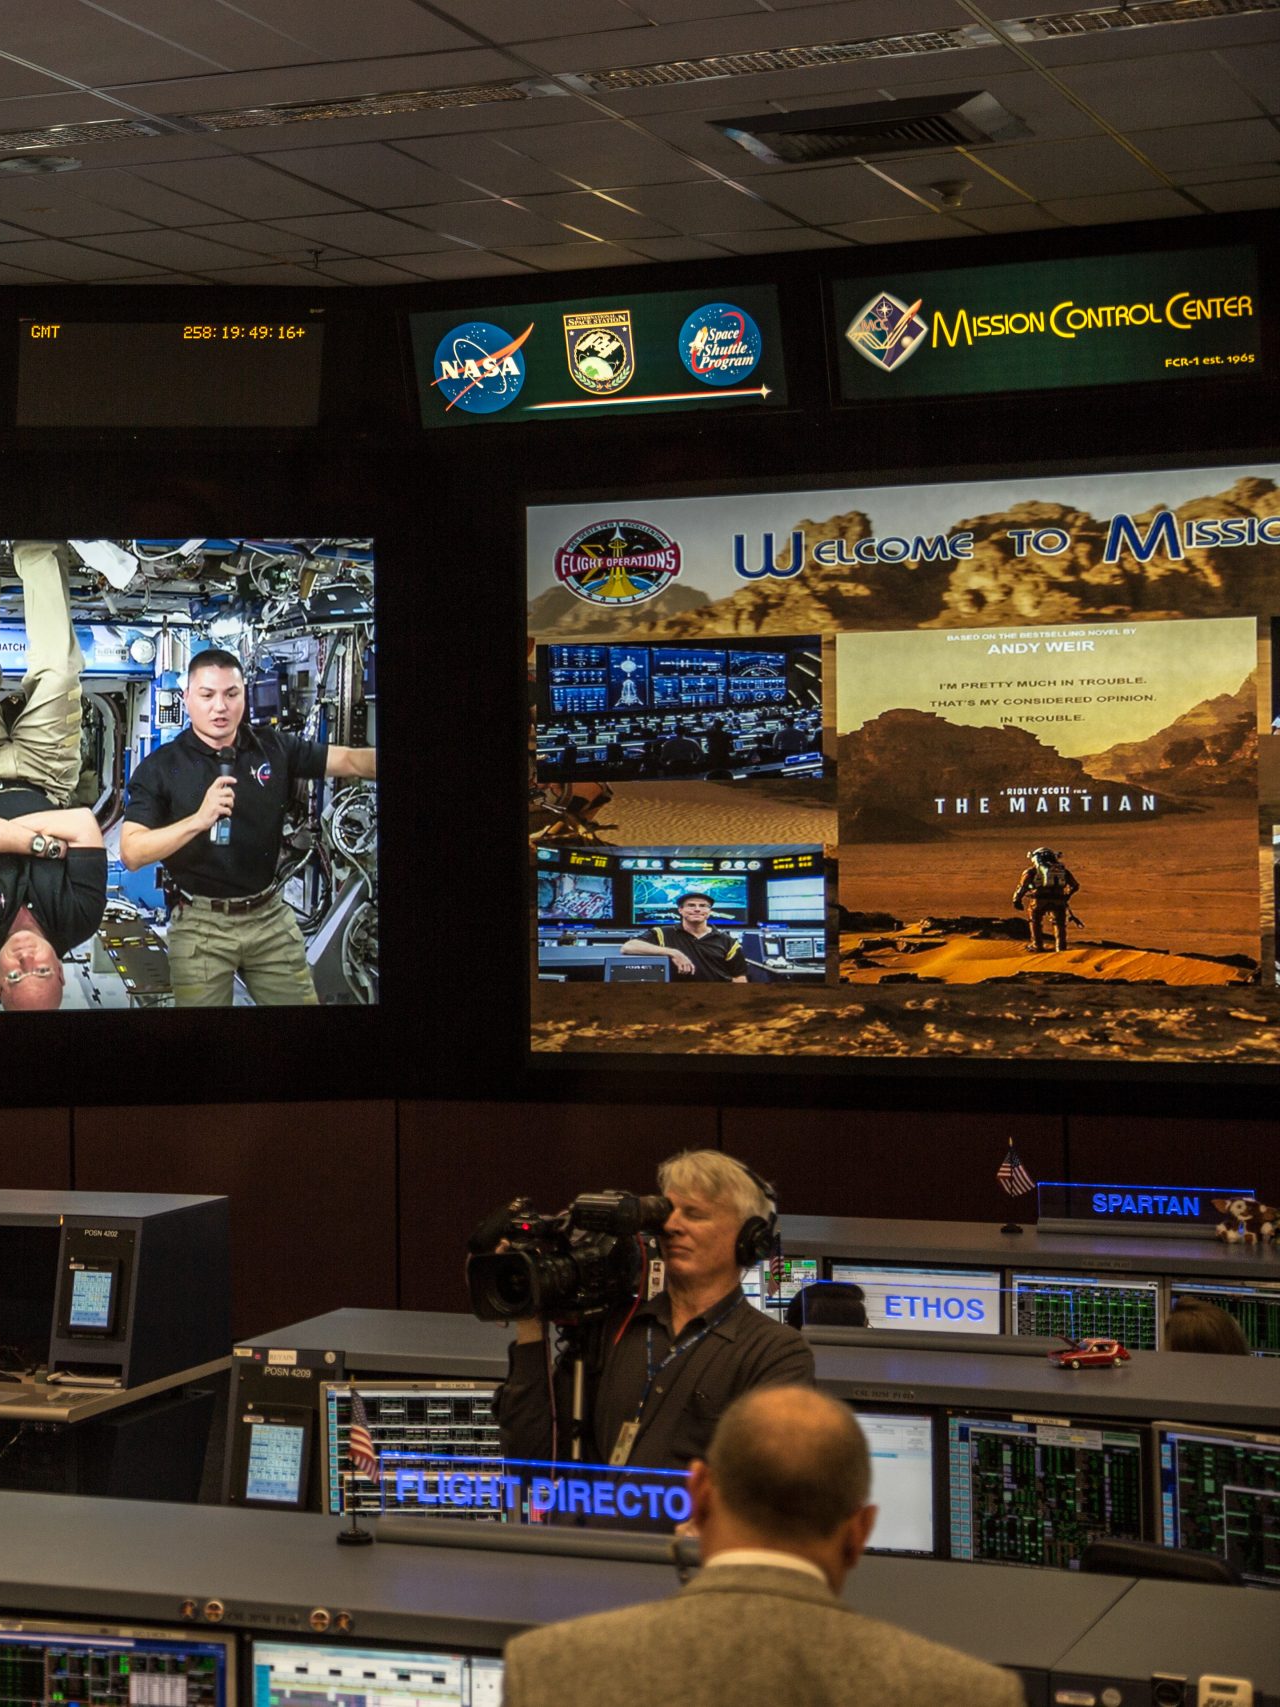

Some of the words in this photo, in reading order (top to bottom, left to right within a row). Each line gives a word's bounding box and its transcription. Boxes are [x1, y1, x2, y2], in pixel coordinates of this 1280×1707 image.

[567, 317, 593, 326] SPACE
[594, 314, 627, 324] STATION
[1049, 301, 1161, 338] CONTROL
[1166, 292, 1253, 329] CENTER
[31, 325, 60, 339] GMT
[708, 327, 740, 342] Space
[703, 341, 748, 356] Shuttle
[440, 356, 521, 380] NASA
[699, 354, 754, 371] Program
[1164, 357, 1199, 368] FCR-1
[1202, 355, 1224, 365] est.
[1226, 353, 1255, 364] 1965
[733, 530, 974, 580] WELCOME
[1007, 528, 1071, 557] TO
[561, 554, 605, 576] FLIGHT
[606, 550, 676, 569] OPERATIONS
[946, 634, 980, 642] BASED
[982, 633, 997, 641] ON
[998, 632, 1017, 640] THE
[1019, 630, 1086, 639] BESTSELLING
[1087, 628, 1122, 638] NOVEL
[1122, 627, 1137, 636] BY
[987, 642, 1041, 656] ANDY
[1045, 640, 1095, 653] WEIR
[939, 682, 958, 690] I'M
[961, 681, 1013, 690] PRETTY
[1017, 679, 1057, 688] MUCH
[1061, 679, 1074, 687] IN
[1078, 676, 1148, 687] TROUBLE.
[929, 699, 976, 708] THAT'S
[979, 697, 999, 706] MY
[1003, 695, 1093, 706] CONSIDERED
[1096, 694, 1157, 704] OPINION.
[999, 715, 1014, 724] IN
[1017, 713, 1086, 724] TROUBLE.
[1006, 787, 1039, 796] RIDLEY
[1042, 786, 1070, 795] SCOTT
[934, 797, 990, 814] THE
[1009, 794, 1156, 813] MARTIAN
[1092, 1193, 1200, 1216] SPARTAN
[84, 1229, 102, 1237] POSN
[103, 1230, 119, 1238] 4202
[884, 1294, 985, 1322] ETHOS
[264, 1366, 290, 1377] POSN
[291, 1368, 312, 1379] 4209
[396, 1468, 520, 1509] FLIGHT
[532, 1475, 693, 1522] DIRECTO
